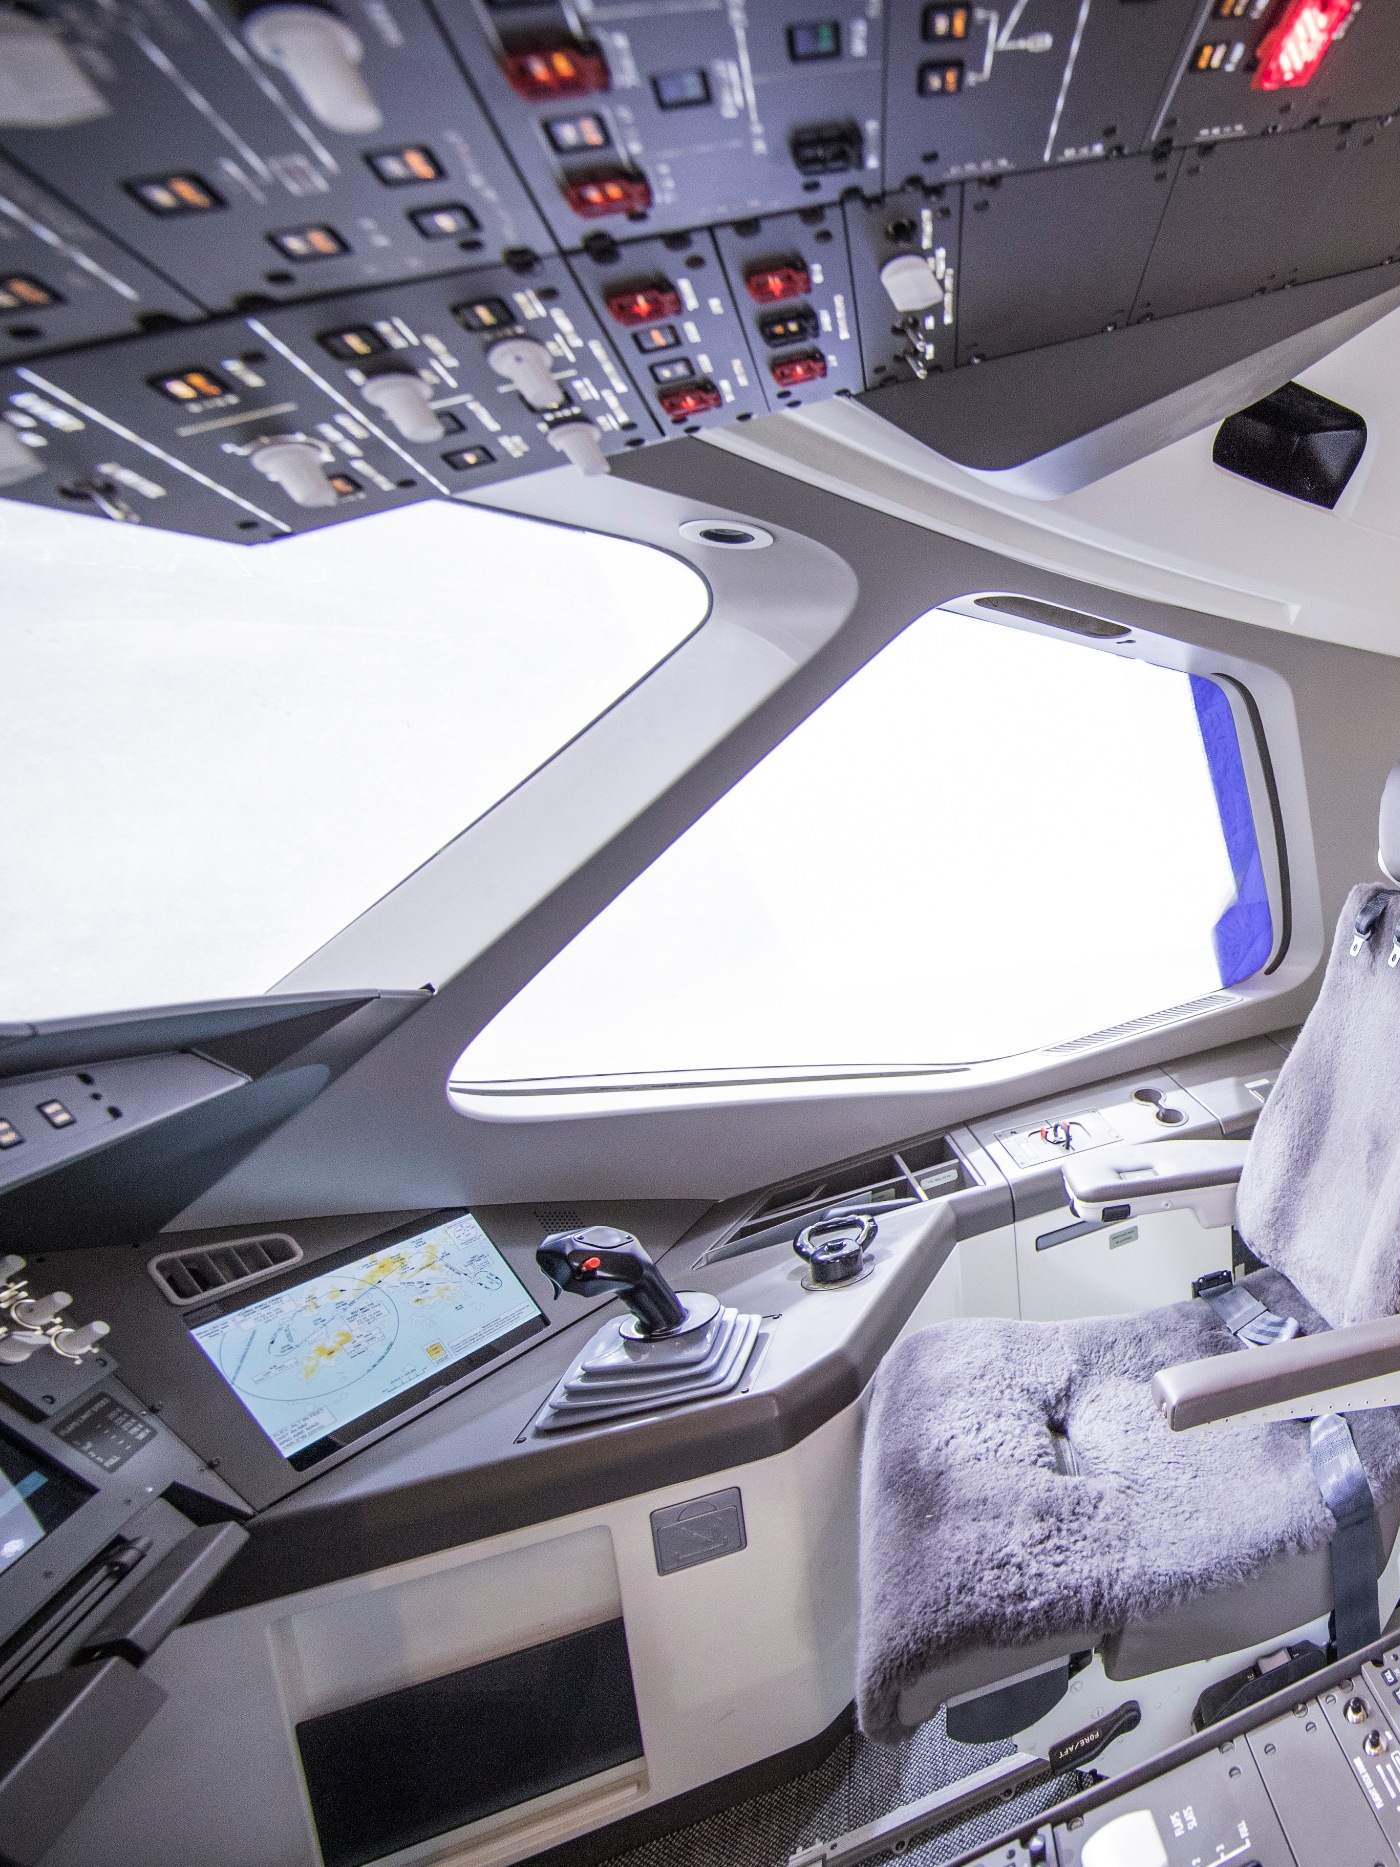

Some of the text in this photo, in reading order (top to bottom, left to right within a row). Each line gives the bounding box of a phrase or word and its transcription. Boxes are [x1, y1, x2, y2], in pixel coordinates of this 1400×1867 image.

[1059, 1731, 1100, 1758] FORE/AFT
[1170, 1811, 1185, 1838] FLAPS
[1182, 1805, 1198, 1830] SLATS
[1237, 1819, 1249, 1839] FULL
[1216, 1844, 1225, 1852] 3
